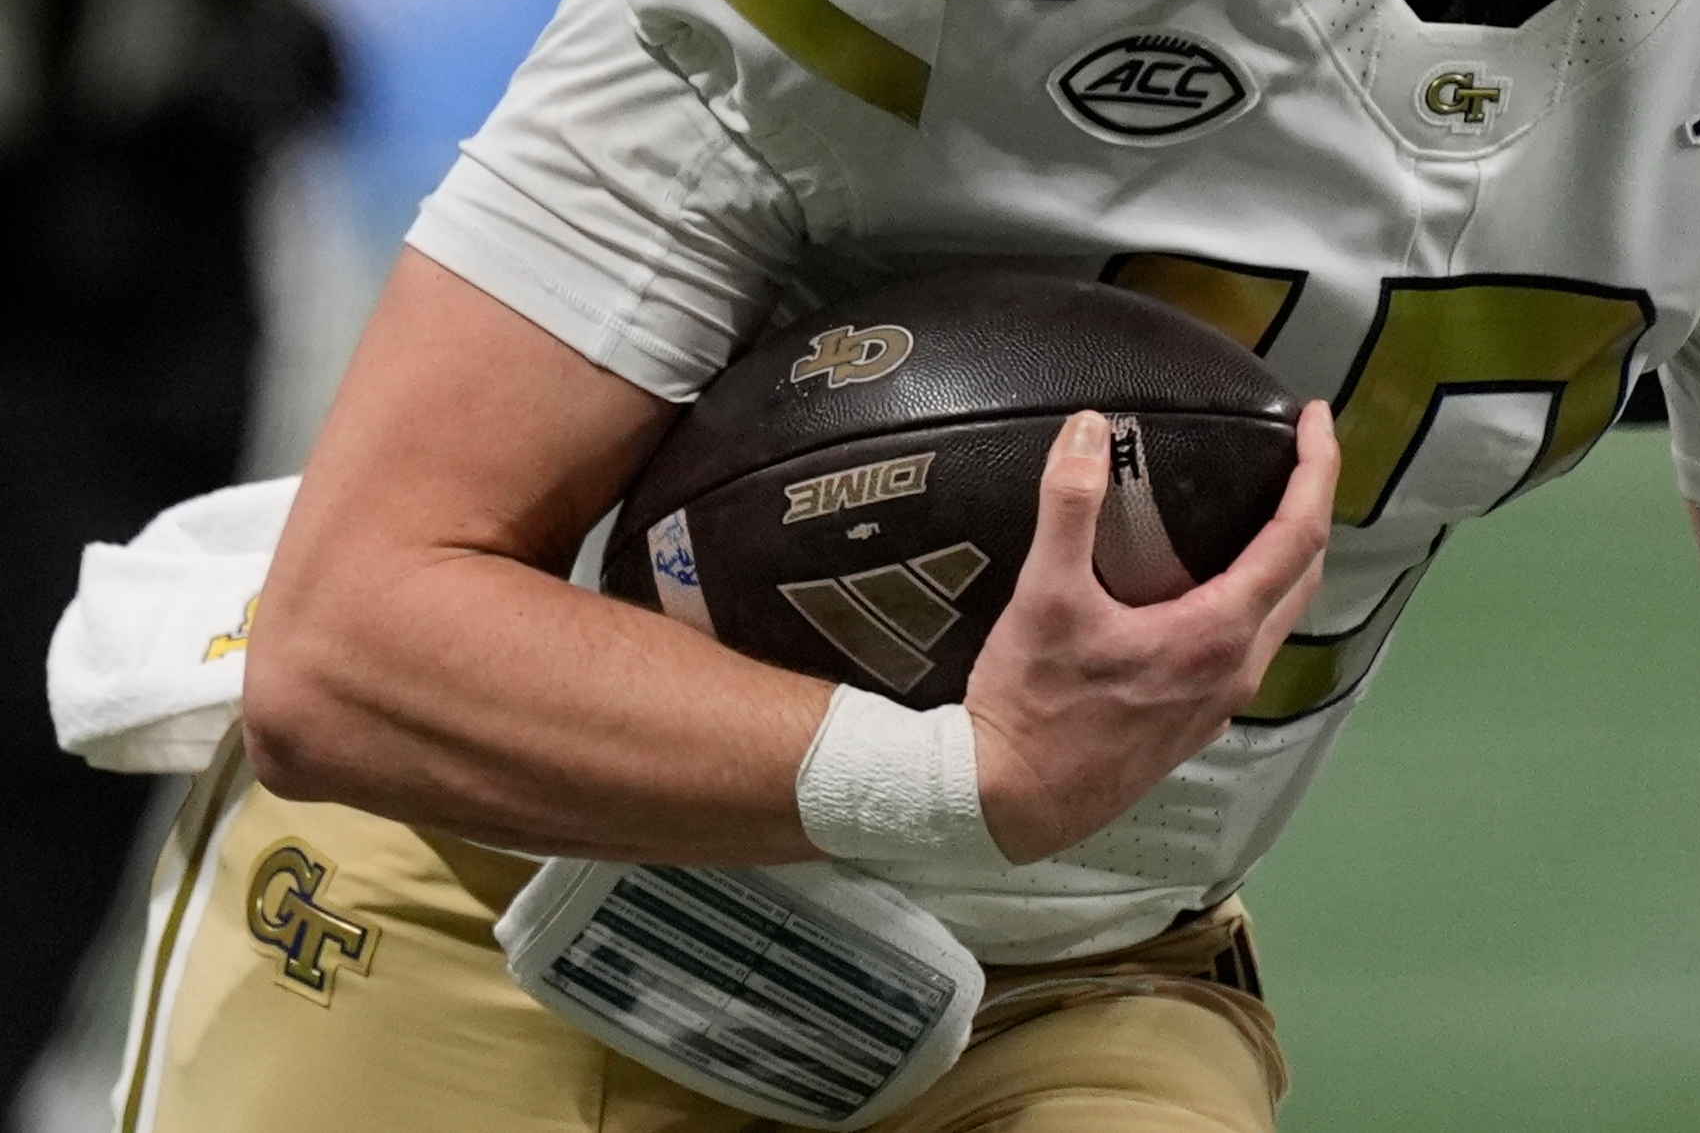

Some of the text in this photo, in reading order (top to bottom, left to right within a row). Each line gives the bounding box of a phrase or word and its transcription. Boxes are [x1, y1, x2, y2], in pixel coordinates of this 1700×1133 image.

[1082, 58, 1222, 107] ACC
[1425, 71, 1504, 125] GT
[790, 323, 915, 388] GT
[781, 451, 937, 525] DIME
[245, 844, 369, 991] GT
